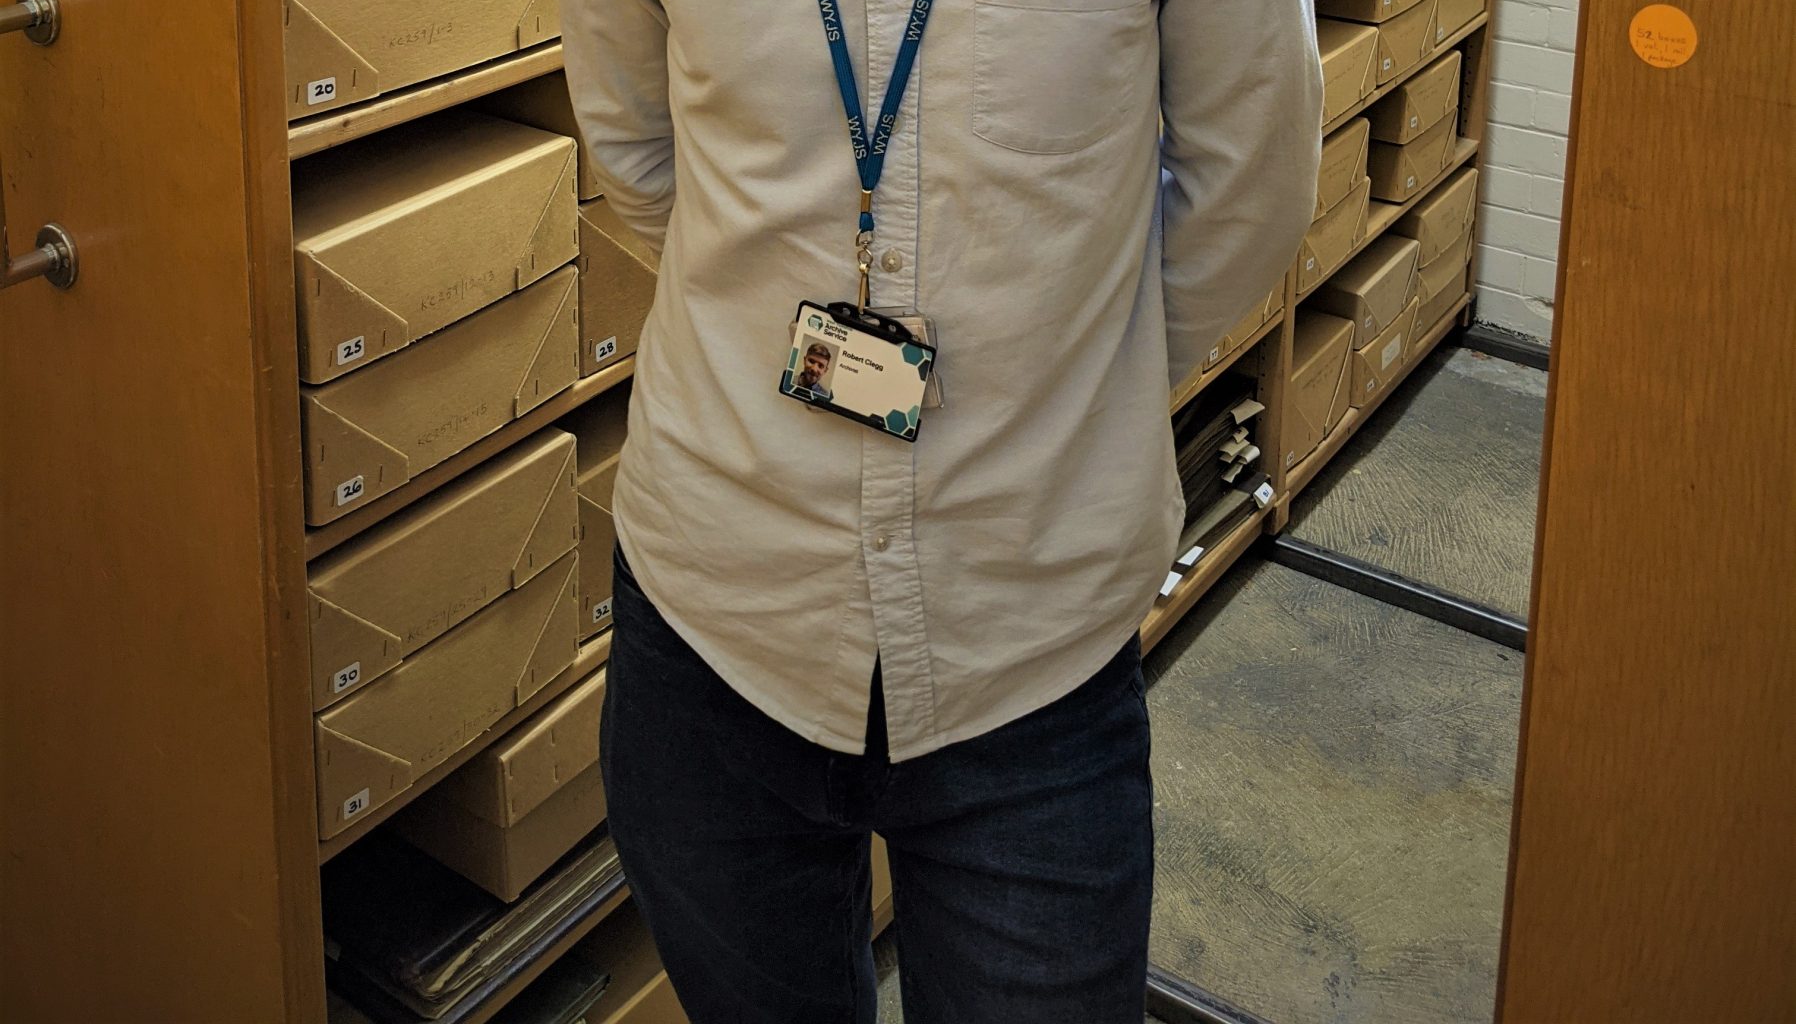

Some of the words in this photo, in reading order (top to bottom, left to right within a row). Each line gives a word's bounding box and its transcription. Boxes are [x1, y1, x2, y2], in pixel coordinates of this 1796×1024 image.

[906, 0, 929, 42] WYJS
[315, 83, 334, 97] 20
[848, 116, 867, 160] WYJS
[873, 113, 894, 155] WYJS
[824, 329, 847, 342] Service
[825, 323, 848, 335] Archive
[343, 341, 362, 358] 25
[599, 342, 614, 358] 28
[842, 350, 864, 364] Robert
[864, 359, 884, 372] Clegg
[343, 480, 362, 497] 26
[595, 605, 610, 619] 32
[338, 668, 359, 688] 30
[347, 798, 363, 814] 31
